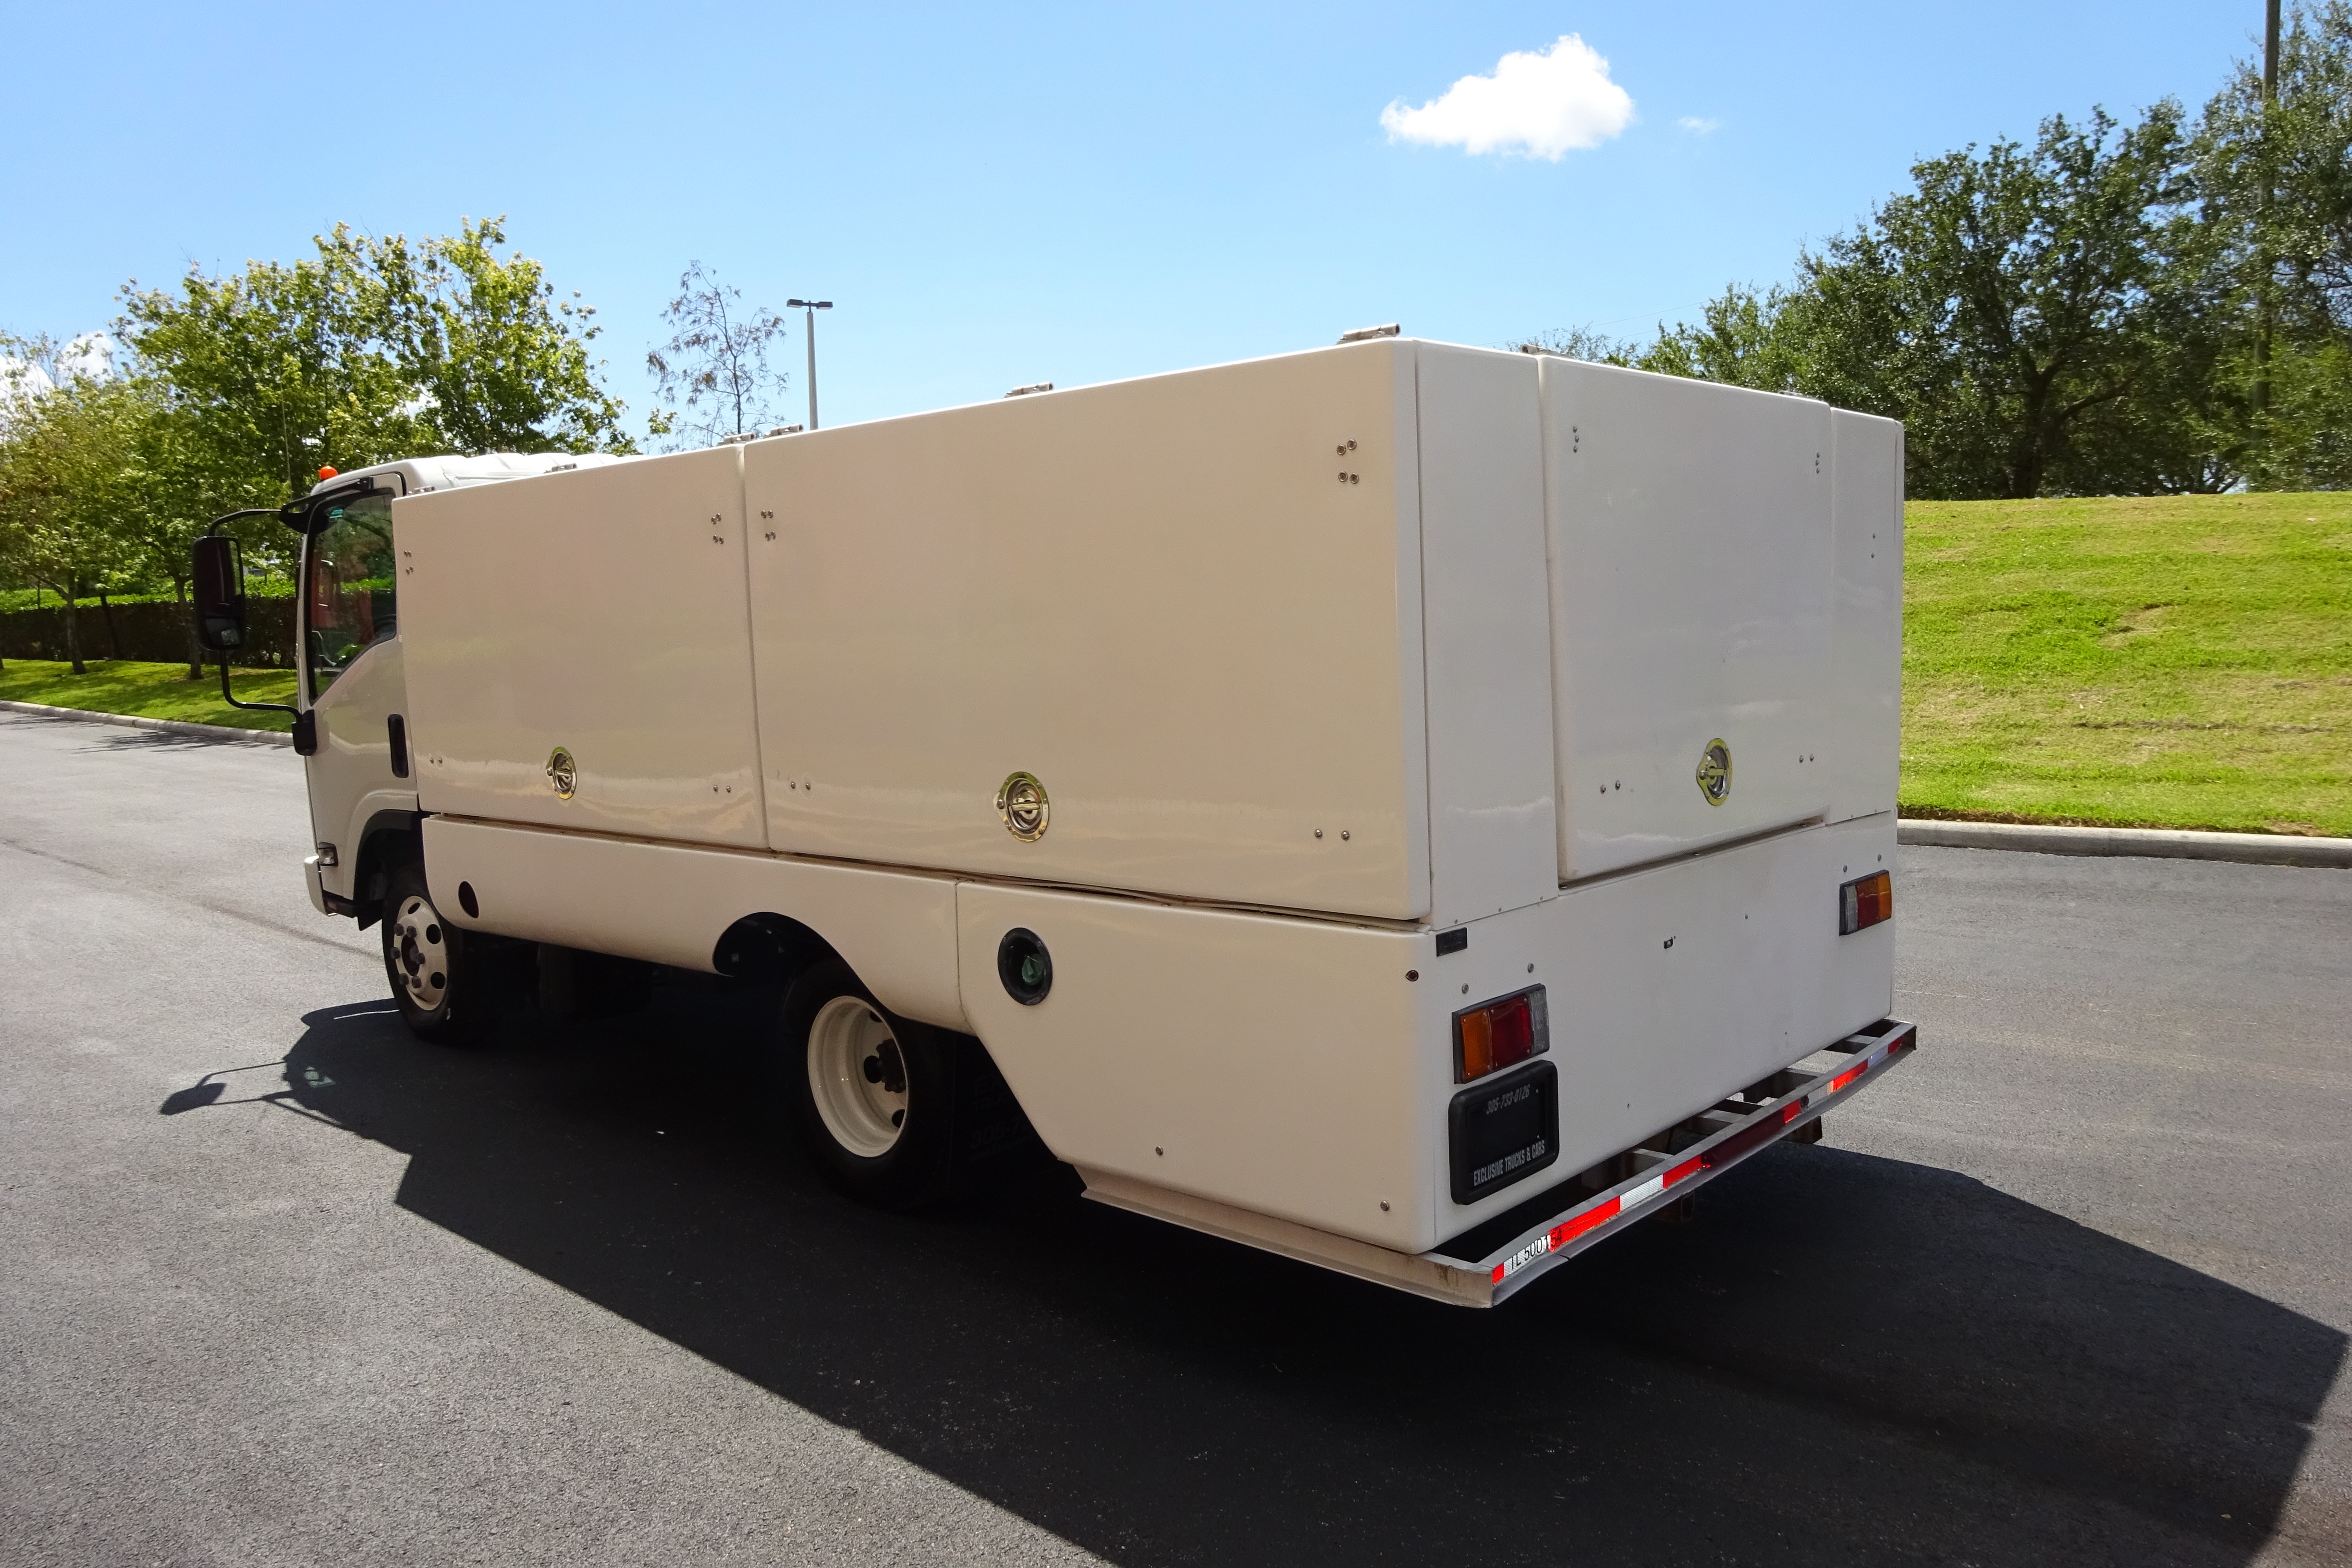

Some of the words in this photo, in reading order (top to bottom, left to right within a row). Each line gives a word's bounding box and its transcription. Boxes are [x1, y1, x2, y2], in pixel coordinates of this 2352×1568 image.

[1473, 1159, 1503, 1186] EXCLUSIVE
[1505, 1150, 1525, 1172] TRUCKS
[1526, 1147, 1531, 1162] &
[1532, 1139, 1544, 1159] CARS
